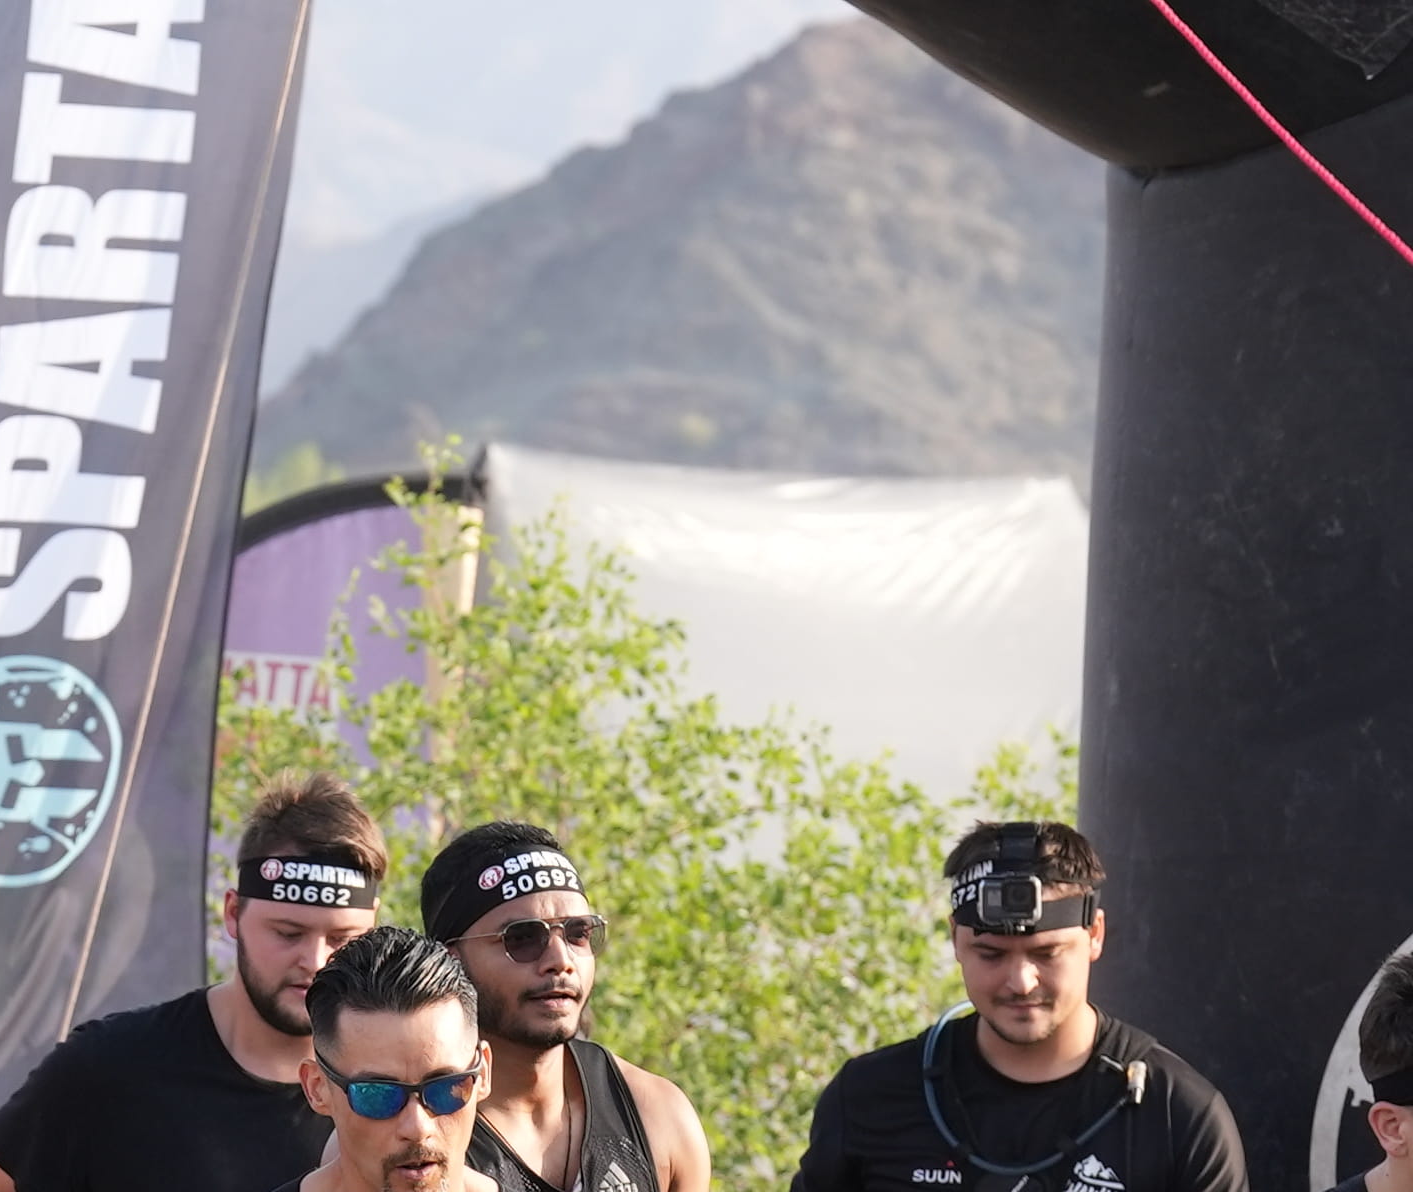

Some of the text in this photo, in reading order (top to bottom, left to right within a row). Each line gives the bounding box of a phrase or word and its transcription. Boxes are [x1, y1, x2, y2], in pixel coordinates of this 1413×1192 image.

[223, 658, 331, 713] ATTA
[272, 883, 352, 906] 50662
[501, 868, 580, 900] 50692
[912, 1168, 962, 1184] SUUN
